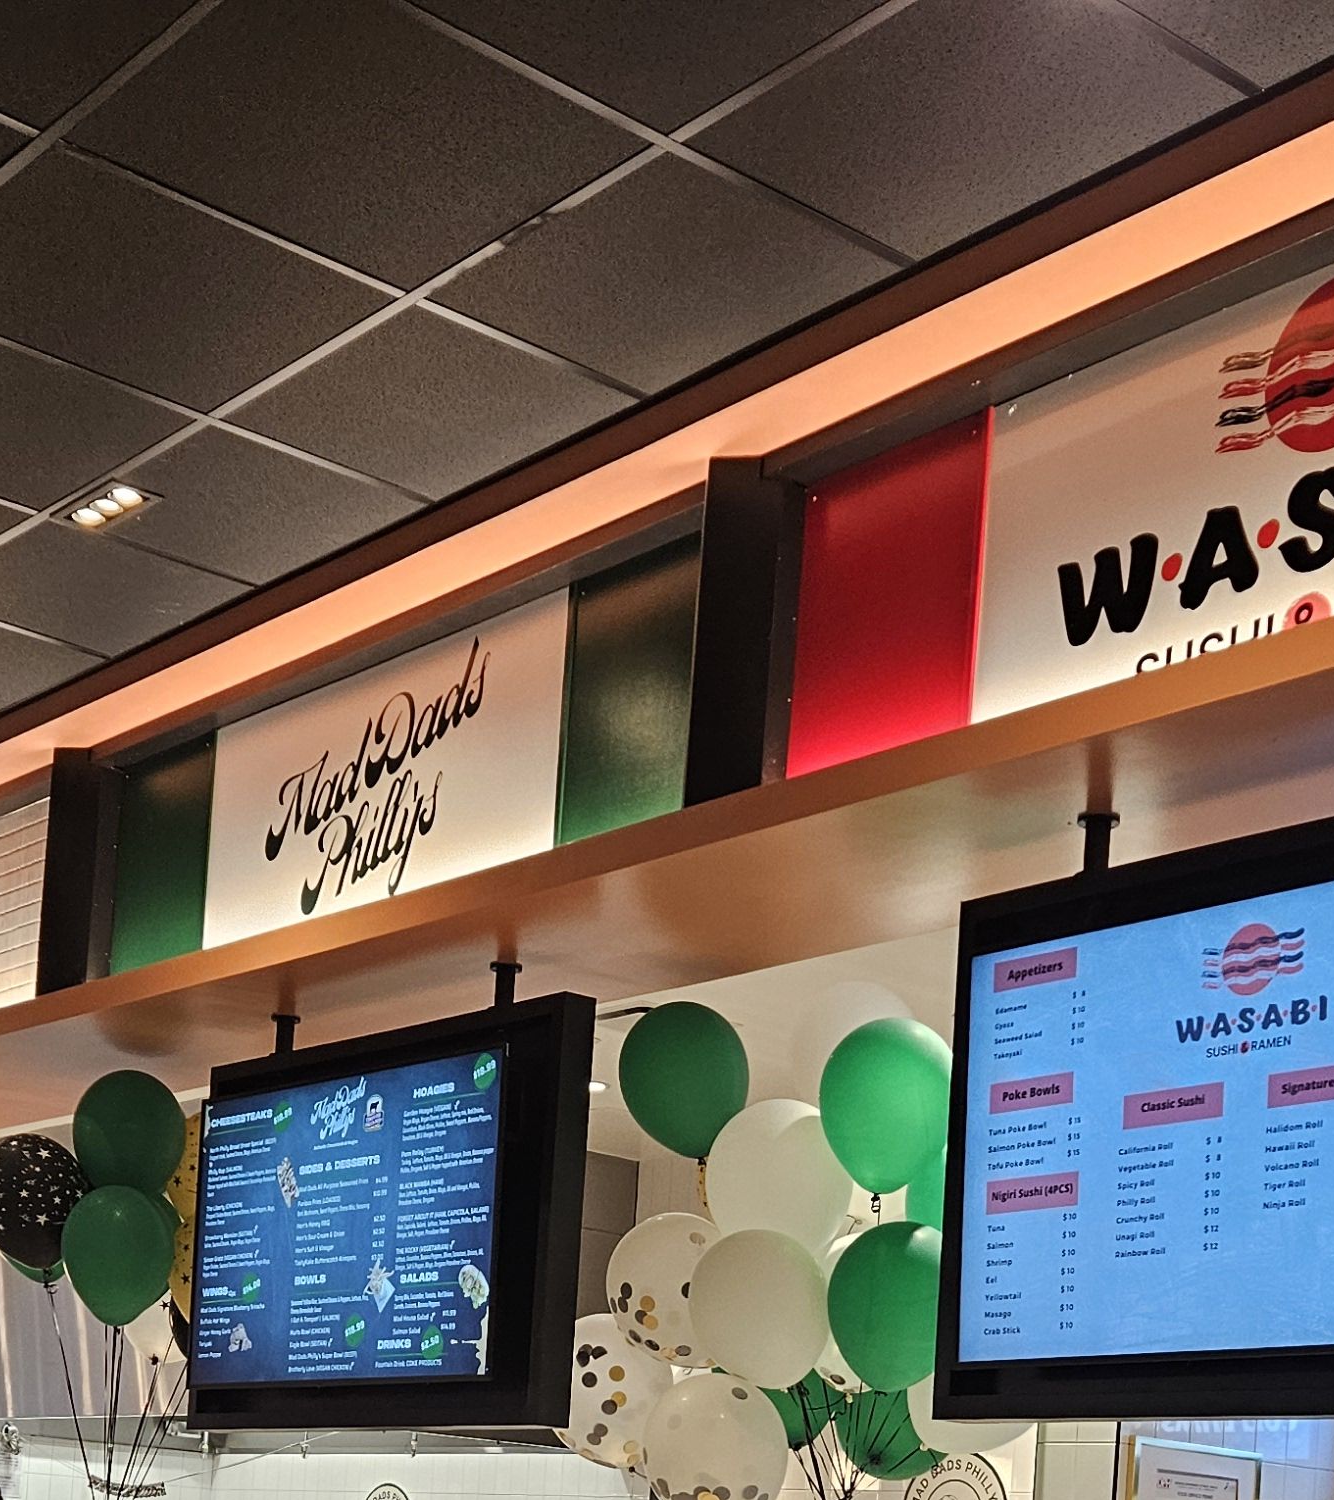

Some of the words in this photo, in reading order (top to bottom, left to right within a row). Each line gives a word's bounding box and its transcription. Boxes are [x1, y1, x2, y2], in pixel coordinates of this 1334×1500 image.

[265, 717, 373, 862] Mad
[365, 635, 491, 788] Dads
[301, 769, 443, 915] Philly's
[1007, 961, 1064, 982] Appetizers
[995, 1003, 1027, 1015] Edamame
[994, 1034, 1023, 1045] Seaweed
[1024, 1030, 1042, 1040] Salad
[1206, 1043, 1238, 1058] SUSHI
[1251, 1035, 1292, 1051] RAMEN
[413, 1081, 455, 1099] HOAGIES
[1002, 1087, 1027, 1102] Poke
[1030, 1083, 1060, 1098] Bowls
[1281, 1076, 1334, 1096] Signature
[1140, 1098, 1176, 1113] Classic
[1177, 1094, 1205, 1109] Sushi
[211, 1108, 273, 1128] CHEESESTEAKS
[989, 1129, 1006, 1137] Tuna
[1008, 1125, 1026, 1135] Poke
[1028, 1121, 1047, 1132] Bowl
[1305, 1120, 1323, 1130] Roll
[988, 1143, 1015, 1154] Salmon
[1017, 1141, 1035, 1150] Poke
[1036, 1138, 1056, 1148] Bowl
[1118, 1143, 1156, 1156] California
[1157, 1142, 1174, 1151] Roll
[1265, 1142, 1296, 1153] Hawaii
[1298, 1140, 1315, 1149] Roll
[299, 1163, 324, 1176] SIDES
[325, 1161, 332, 1171] &
[334, 1154, 380, 1170] DESSERTS
[987, 1162, 1004, 1171] Tofu
[1005, 1160, 1023, 1169] Poke
[1025, 1157, 1044, 1167] Bowl
[1118, 1161, 1158, 1173] Vegetable
[1159, 1160, 1174, 1169] Roll
[1264, 1161, 1300, 1173] Volcano
[1302, 1159, 1319, 1168] Roll
[1117, 1181, 1139, 1191] Spicy
[1140, 1179, 1155, 1188] Roll
[1263, 1181, 1286, 1192] Tiger
[1288, 1179, 1306, 1188] Roll
[991, 1189, 1017, 1202] Nigiri
[1018, 1186, 1043, 1199] Sushi
[1044, 1182, 1073, 1197] (4PCS)
[1116, 1198, 1140, 1208] Philly
[1141, 1197, 1156, 1205] Roll
[1262, 1200, 1286, 1210] Ninja
[1288, 1198, 1306, 1207] Roll
[1116, 1215, 1148, 1225] Crunchy
[1149, 1213, 1165, 1222] Roll
[988, 1224, 1006, 1233] Tuna
[1115, 1233, 1137, 1242] Unagi
[1139, 1231, 1155, 1240] Roll
[986, 1240, 1014, 1250] Salmon
[1115, 1249, 1149, 1259] Rainbow
[1150, 1247, 1166, 1256] Roll
[986, 1258, 1013, 1267] Shrimp
[294, 1274, 327, 1286] BOWLS
[400, 1271, 439, 1284] SALADS
[985, 1276, 997, 1284] Eel
[202, 1286, 228, 1297] WINGS
[985, 1292, 1022, 1302] Yellowtail
[984, 1310, 1012, 1319] Masago
[983, 1327, 1001, 1336] Crab
[1002, 1326, 1021, 1335] Stick
[377, 1338, 411, 1350] DRINKS
